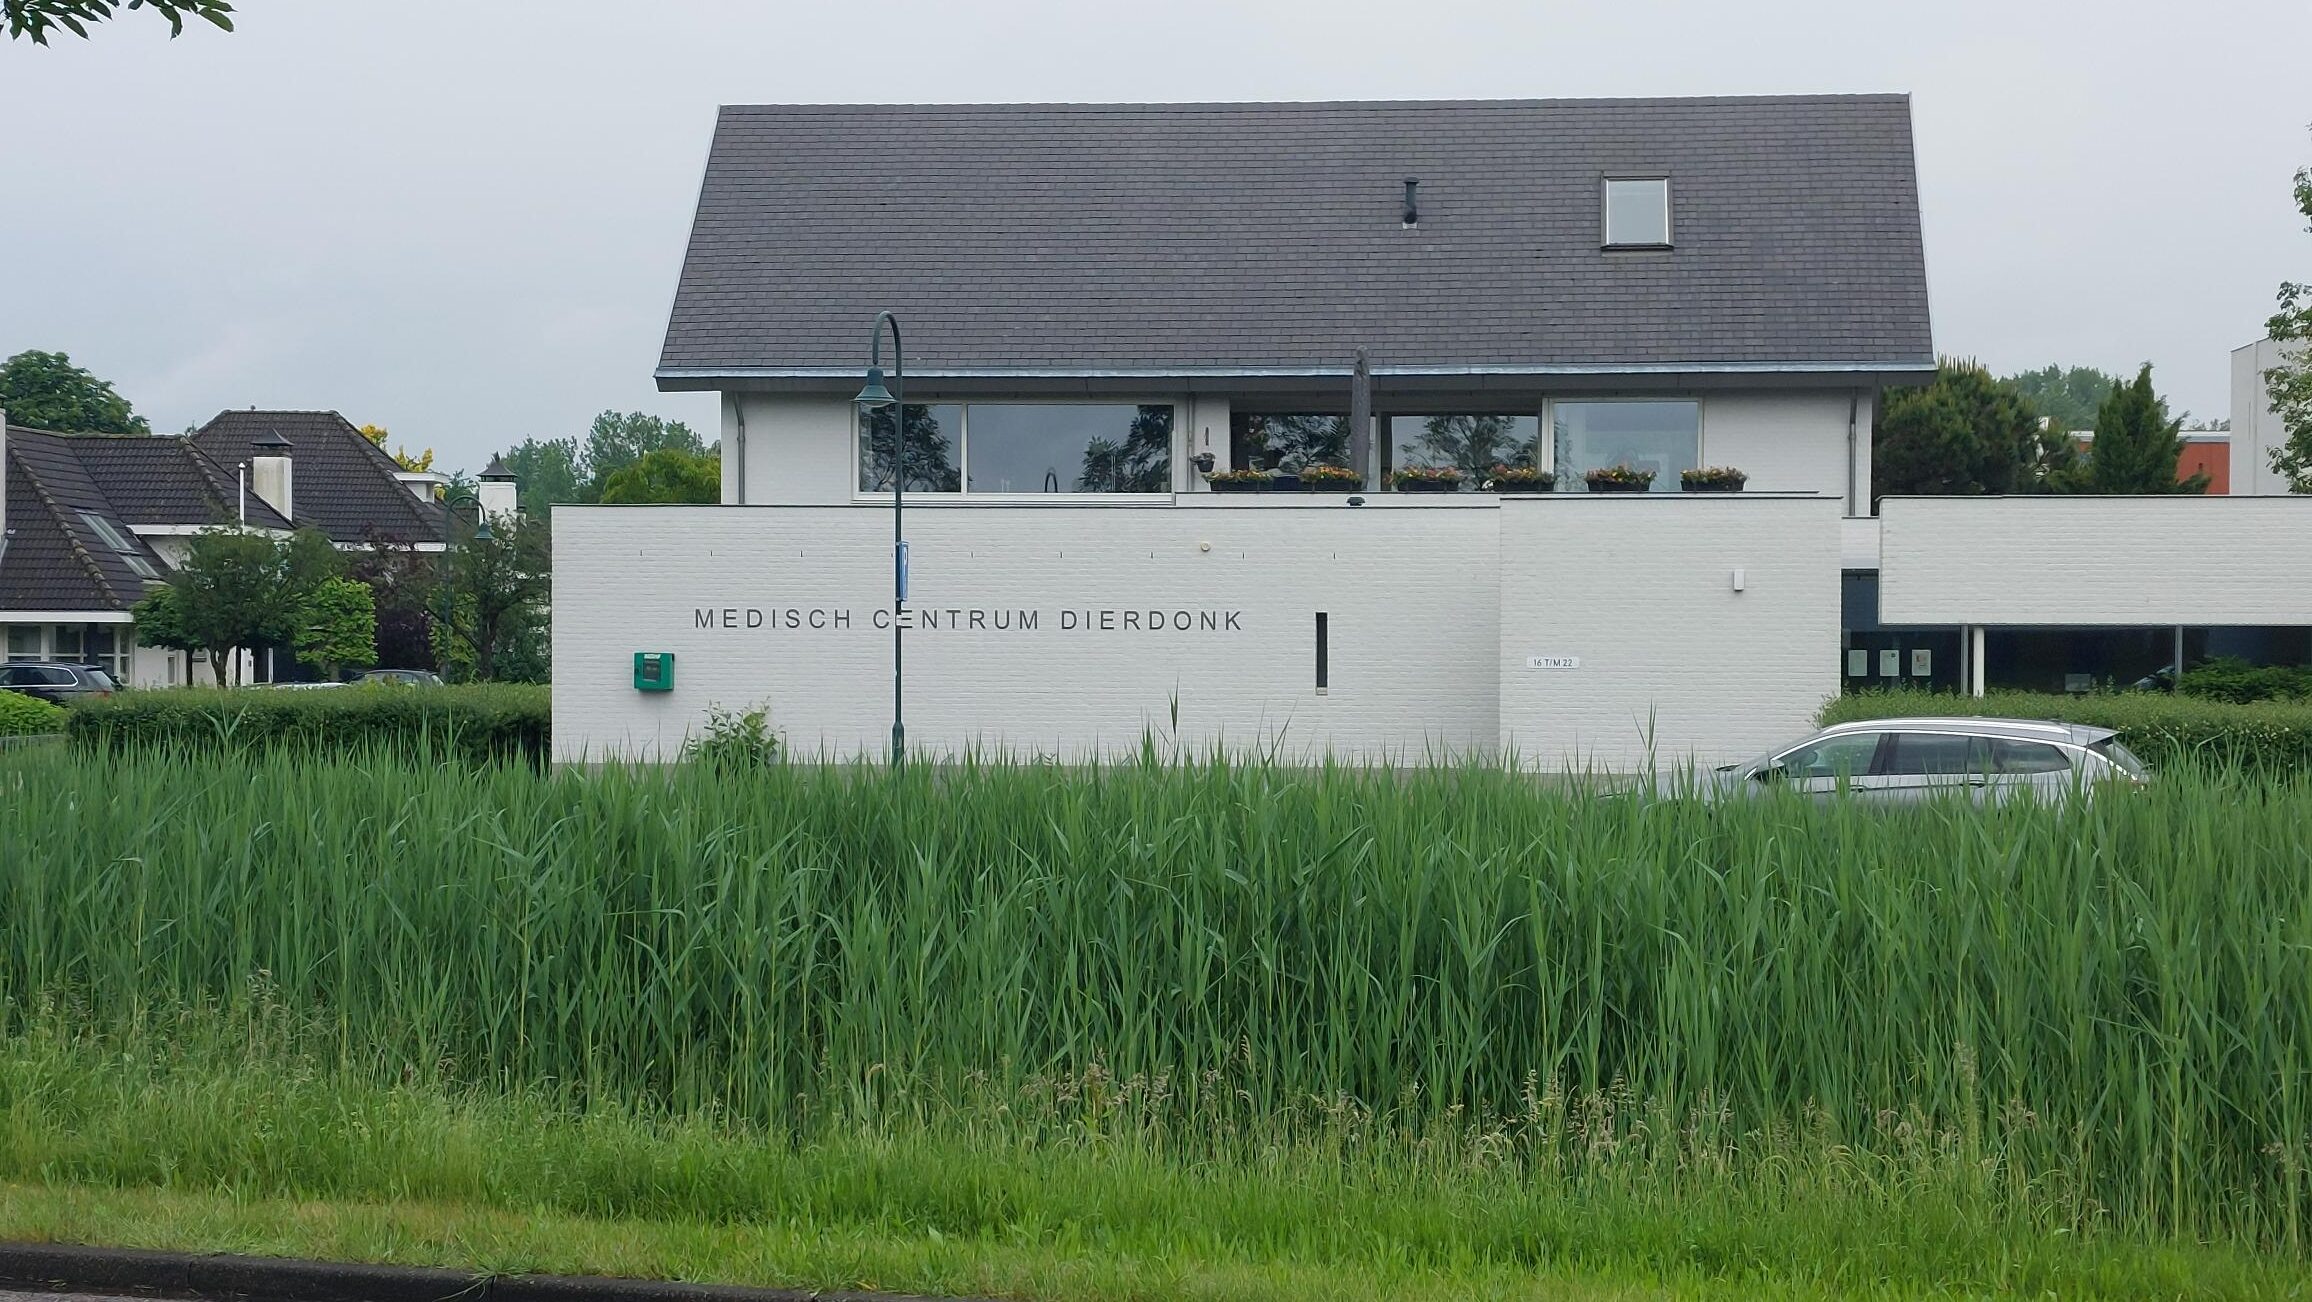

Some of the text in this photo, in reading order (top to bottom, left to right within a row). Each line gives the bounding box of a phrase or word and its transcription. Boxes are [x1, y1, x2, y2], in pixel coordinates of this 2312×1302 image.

[695, 608, 1241, 631] MEDISCH CENTRUM DIERDONK
[1533, 658, 1573, 667] 16 T/M 22
